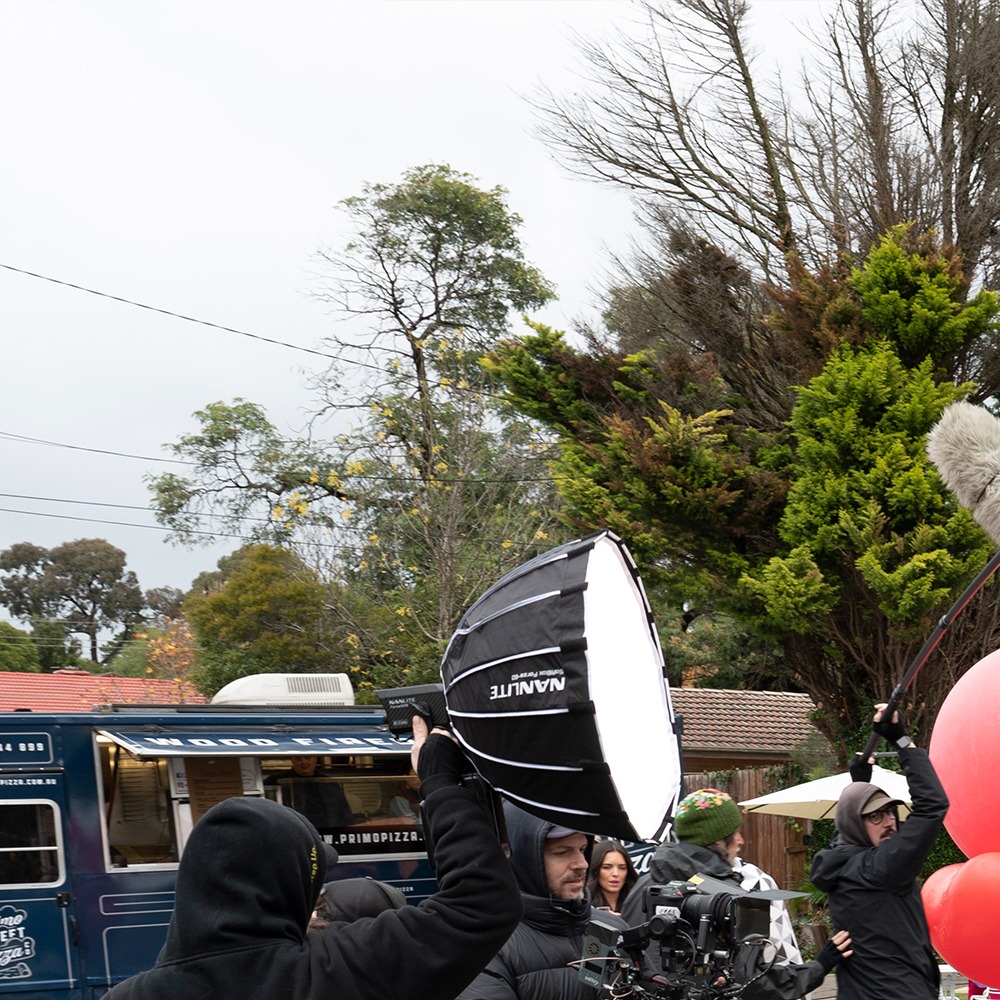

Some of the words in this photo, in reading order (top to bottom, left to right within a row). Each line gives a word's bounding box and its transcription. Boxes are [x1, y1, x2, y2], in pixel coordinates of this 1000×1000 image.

[489, 676, 566, 700] NANLITE
[143, 737, 279, 746] WOOD
[319, 831, 423, 844] W.PRIMOPIZZA.
